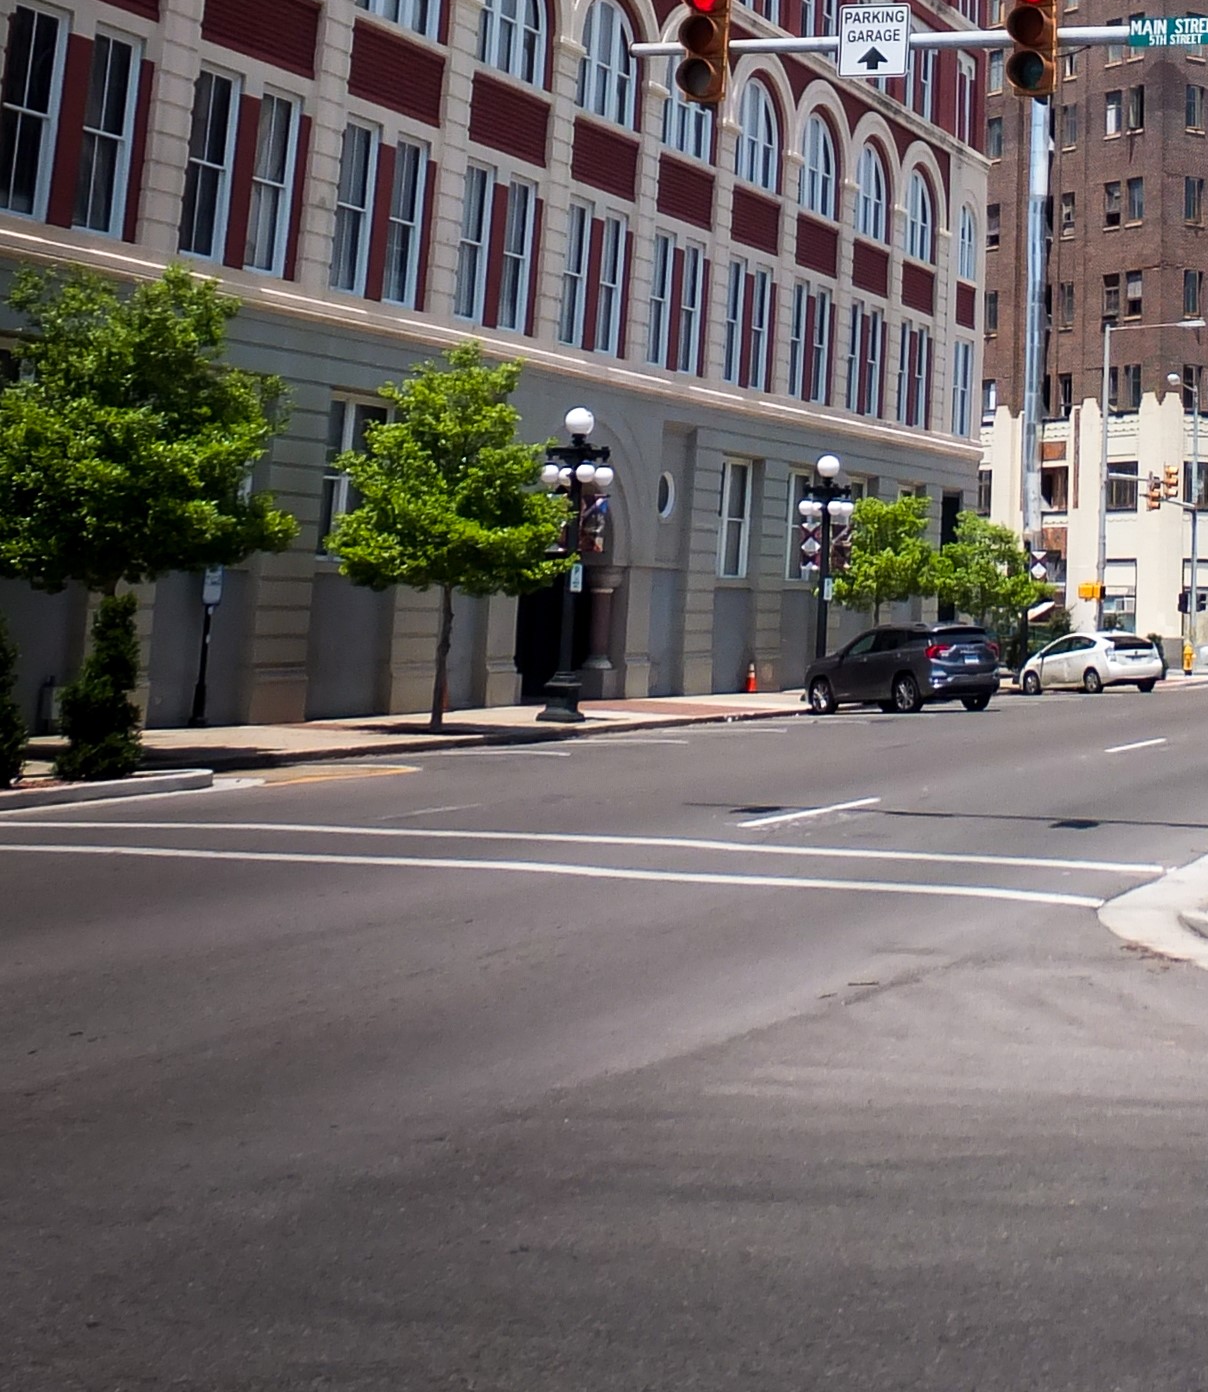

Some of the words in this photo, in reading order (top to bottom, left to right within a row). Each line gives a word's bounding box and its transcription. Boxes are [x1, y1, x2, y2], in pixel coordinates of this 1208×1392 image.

[844, 10, 905, 24] PARKING
[1130, 19, 1168, 36] MAIN
[847, 28, 901, 43] GARAGE
[1148, 34, 1167, 46] 5TH
[1169, 33, 1202, 45] STREET
